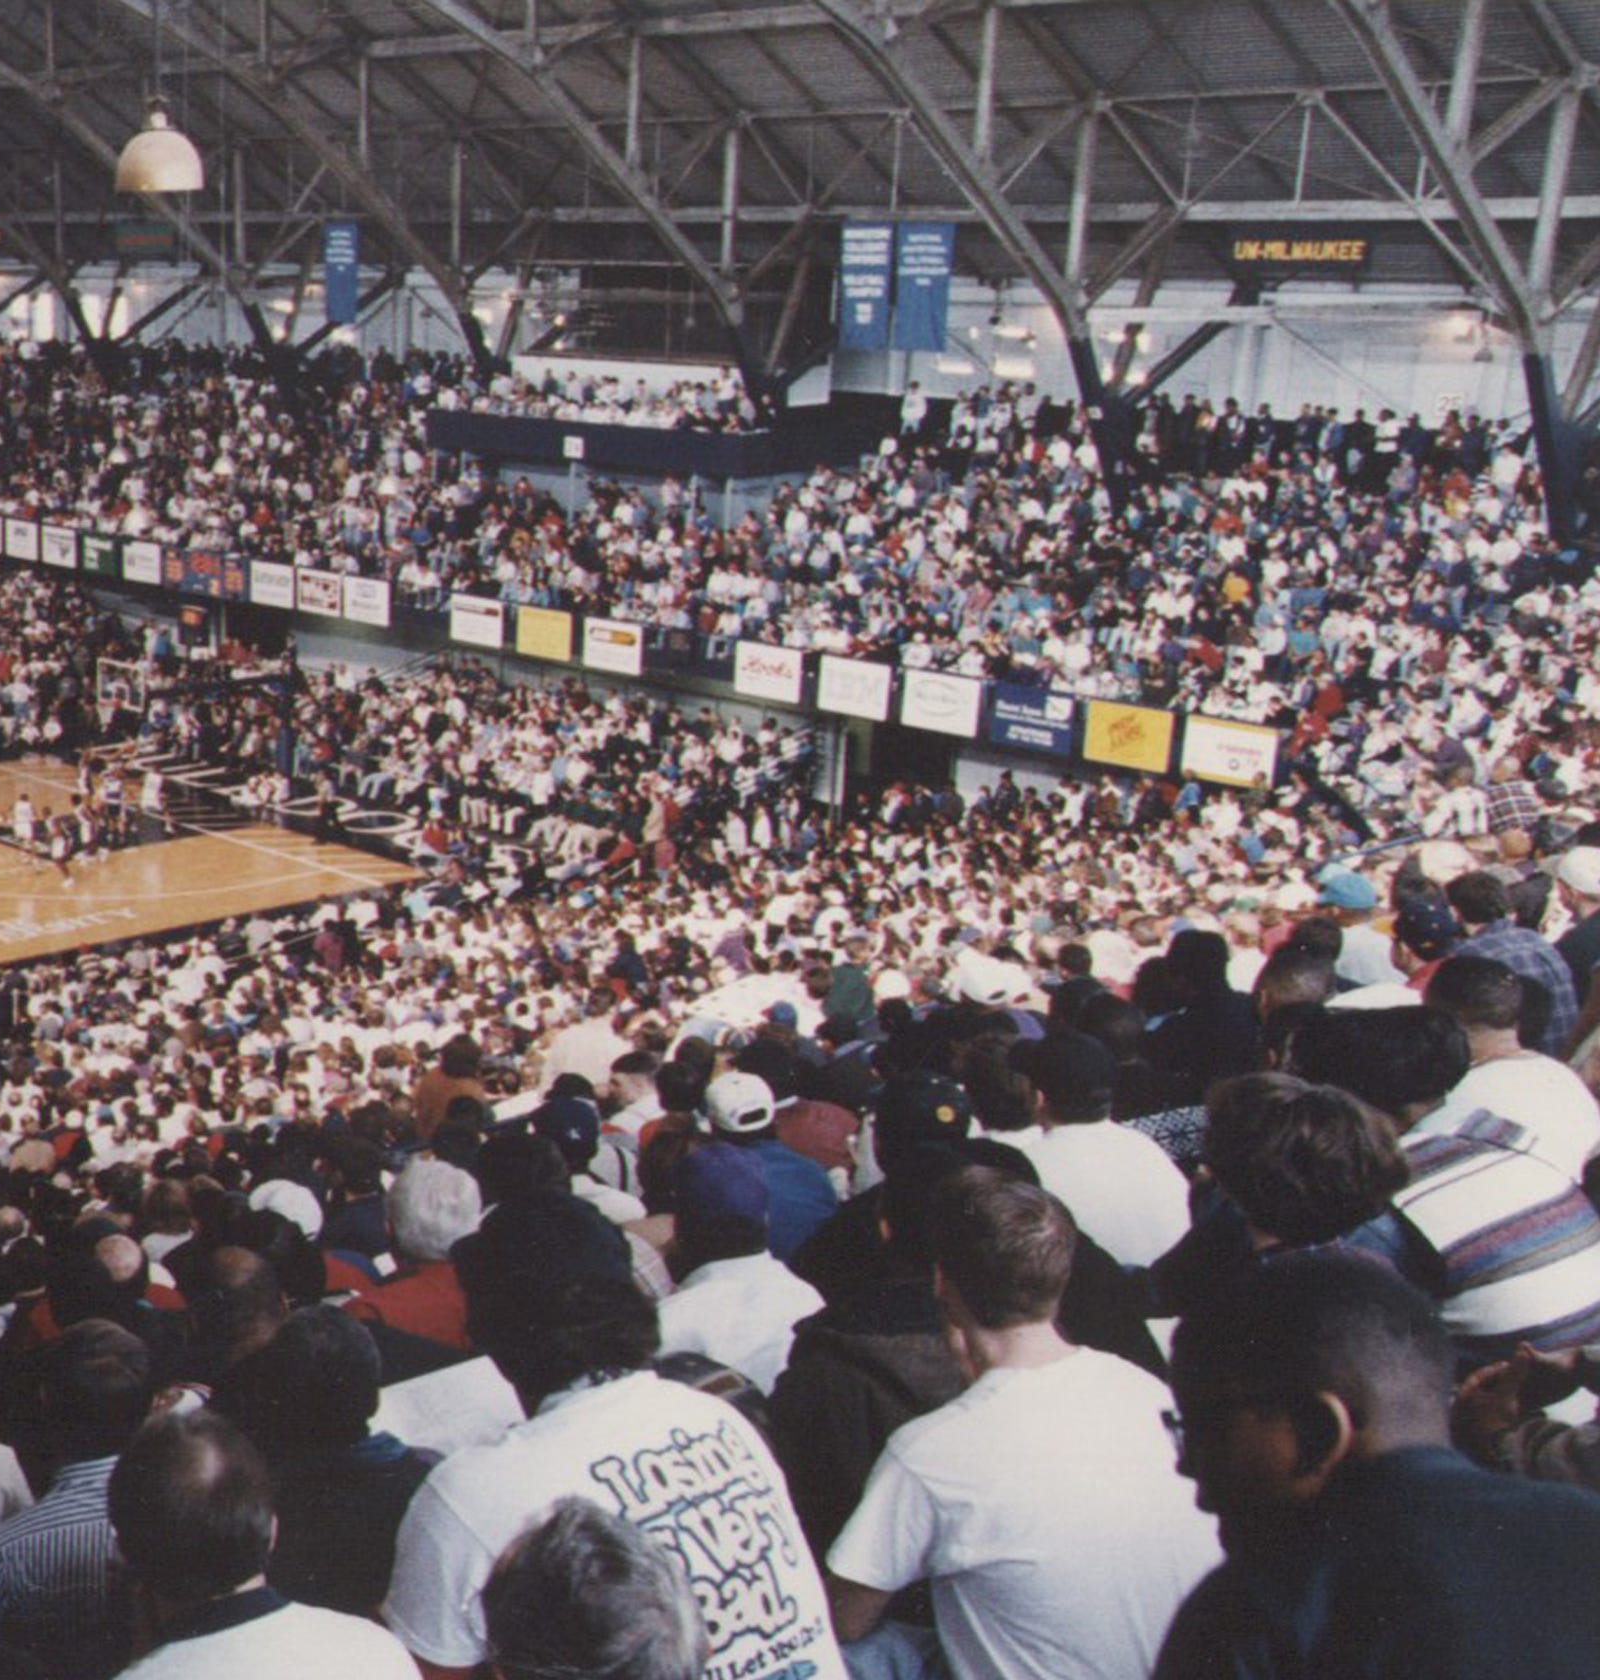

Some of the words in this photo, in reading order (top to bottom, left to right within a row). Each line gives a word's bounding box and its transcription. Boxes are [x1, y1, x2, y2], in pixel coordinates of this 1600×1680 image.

[1233, 239, 1367, 261] UW-MILWAUKEE
[589, 1418, 774, 1530] Losing
[674, 1490, 799, 1574] Very
